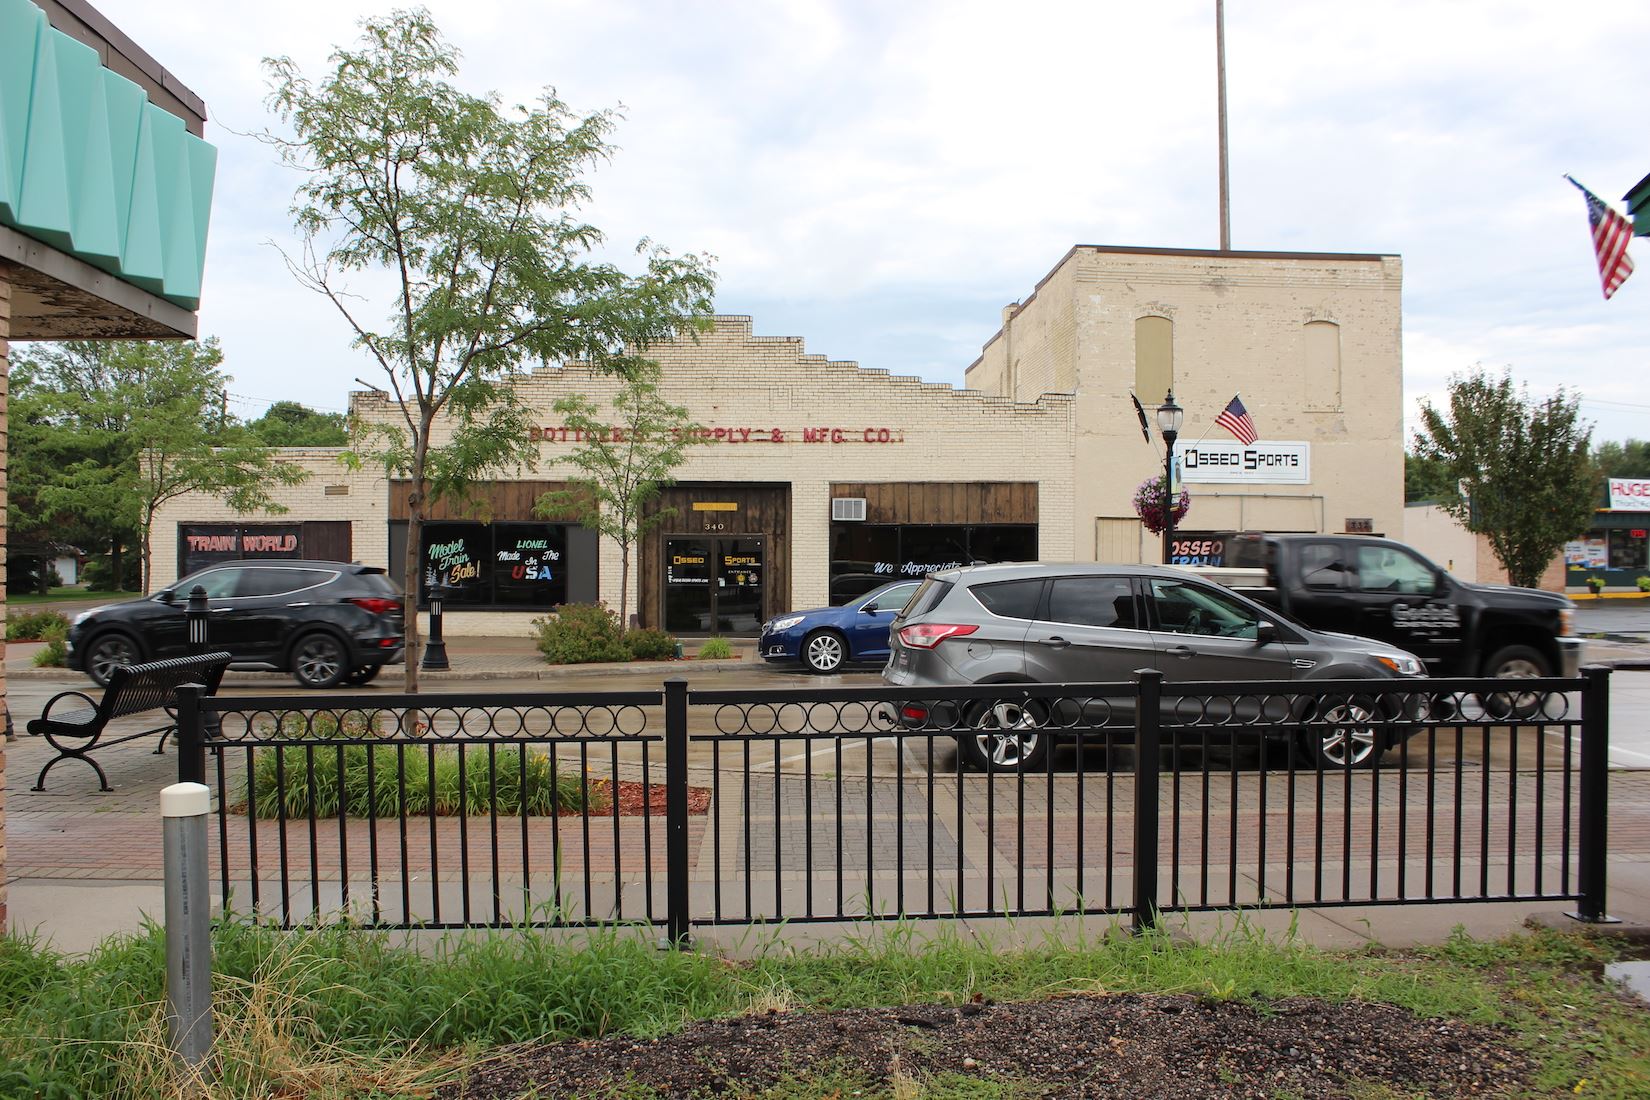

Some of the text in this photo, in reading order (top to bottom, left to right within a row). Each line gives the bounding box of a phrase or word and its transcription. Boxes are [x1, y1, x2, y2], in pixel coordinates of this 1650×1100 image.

[771, 428, 784, 443] &
[1185, 449, 1298, 469] OSSEO SPORTS
[187, 535, 297, 552] TRAIN WORLD
[428, 538, 465, 560] Model
[516, 540, 548, 549] LIONEL
[439, 553, 469, 570] Train
[497, 550, 559, 565] Made In The
[673, 555, 756, 566] OSSEO SPORTS
[450, 560, 480, 583] Sale!
[512, 565, 552, 580] USA
[874, 561, 894, 574] We
